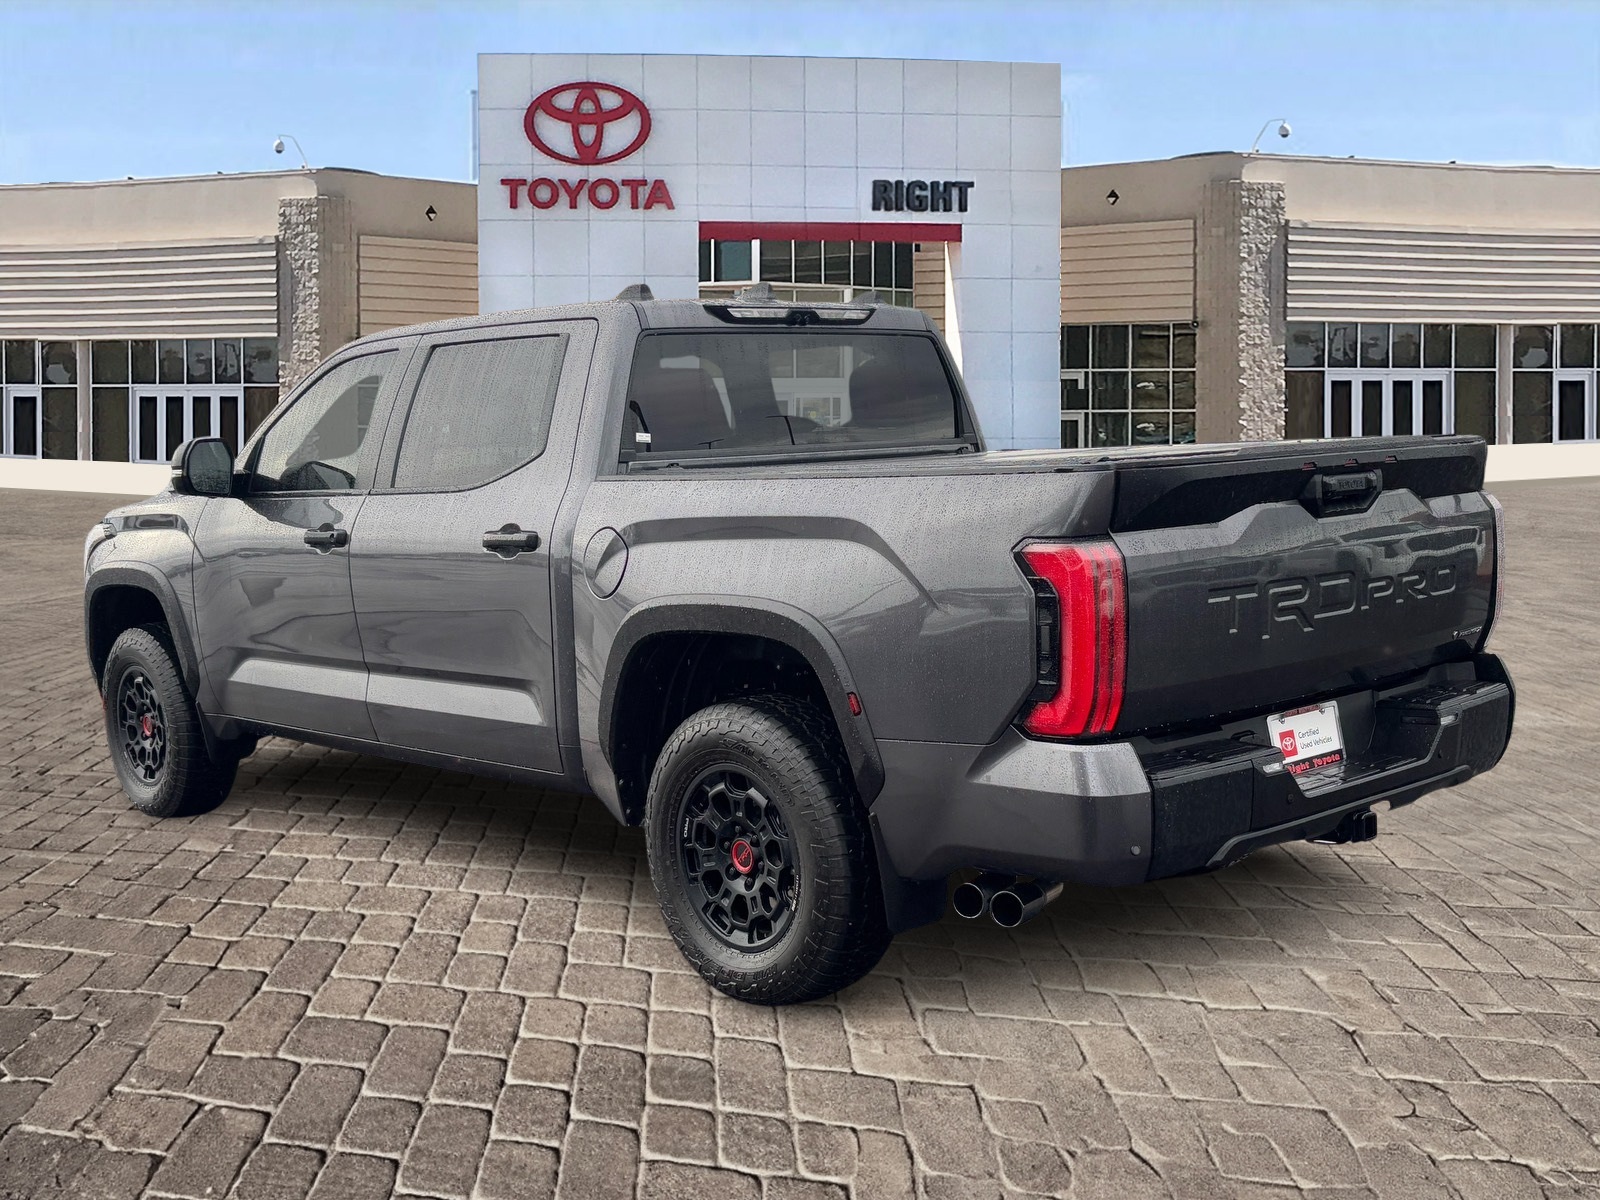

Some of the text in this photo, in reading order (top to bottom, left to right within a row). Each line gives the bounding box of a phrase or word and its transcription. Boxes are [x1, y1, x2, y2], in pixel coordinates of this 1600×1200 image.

[500, 178, 675, 210] TOYOTA
[871, 179, 975, 213] RIGHT
[1338, 479, 1364, 489] TOYOTA
[1207, 564, 1457, 639] TRD PRO
[1298, 727, 1320, 739] Certified
[1299, 735, 1333, 750] Used Vehicles
[1313, 753, 1341, 768] Toyota
